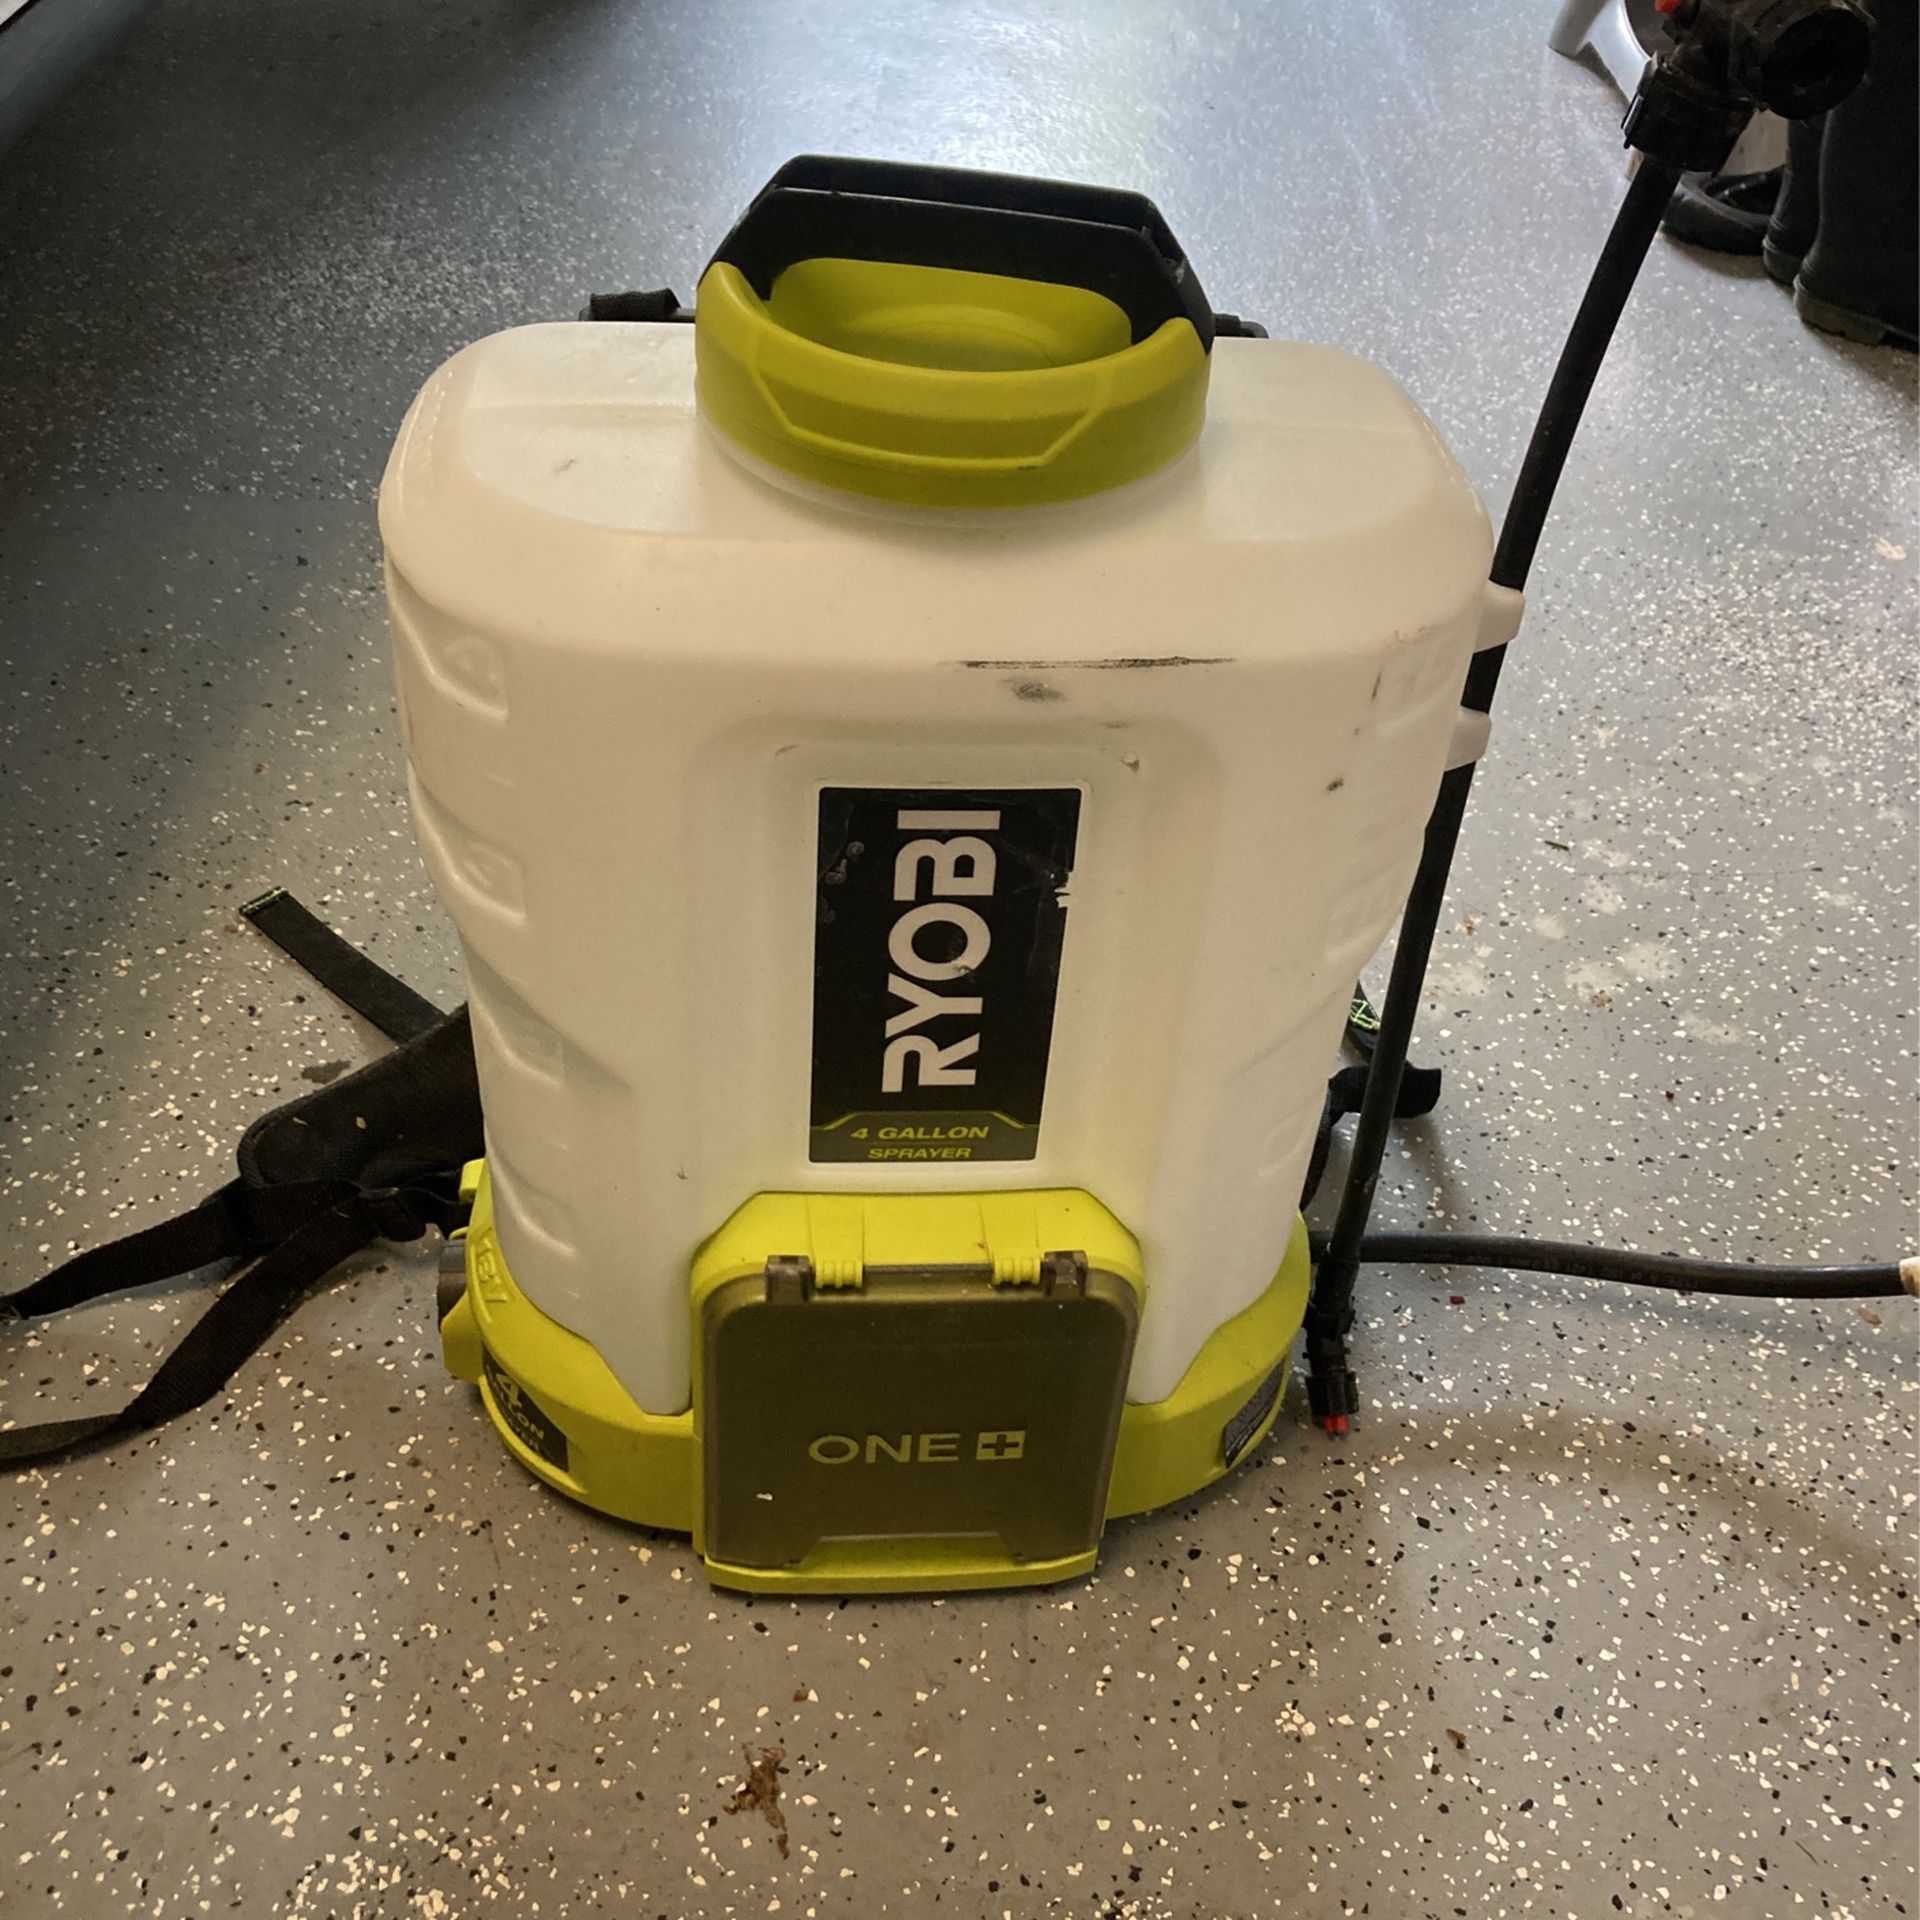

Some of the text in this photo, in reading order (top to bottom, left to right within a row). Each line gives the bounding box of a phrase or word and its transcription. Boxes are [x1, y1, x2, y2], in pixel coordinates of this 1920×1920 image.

[881, 809, 1001, 1093] RYOBI
[850, 1126, 990, 1139] 4 GALLON
[867, 1147, 972, 1159] SPRAYER
[495, 1372, 522, 1408] 4
[808, 1432, 960, 1465] ONE
